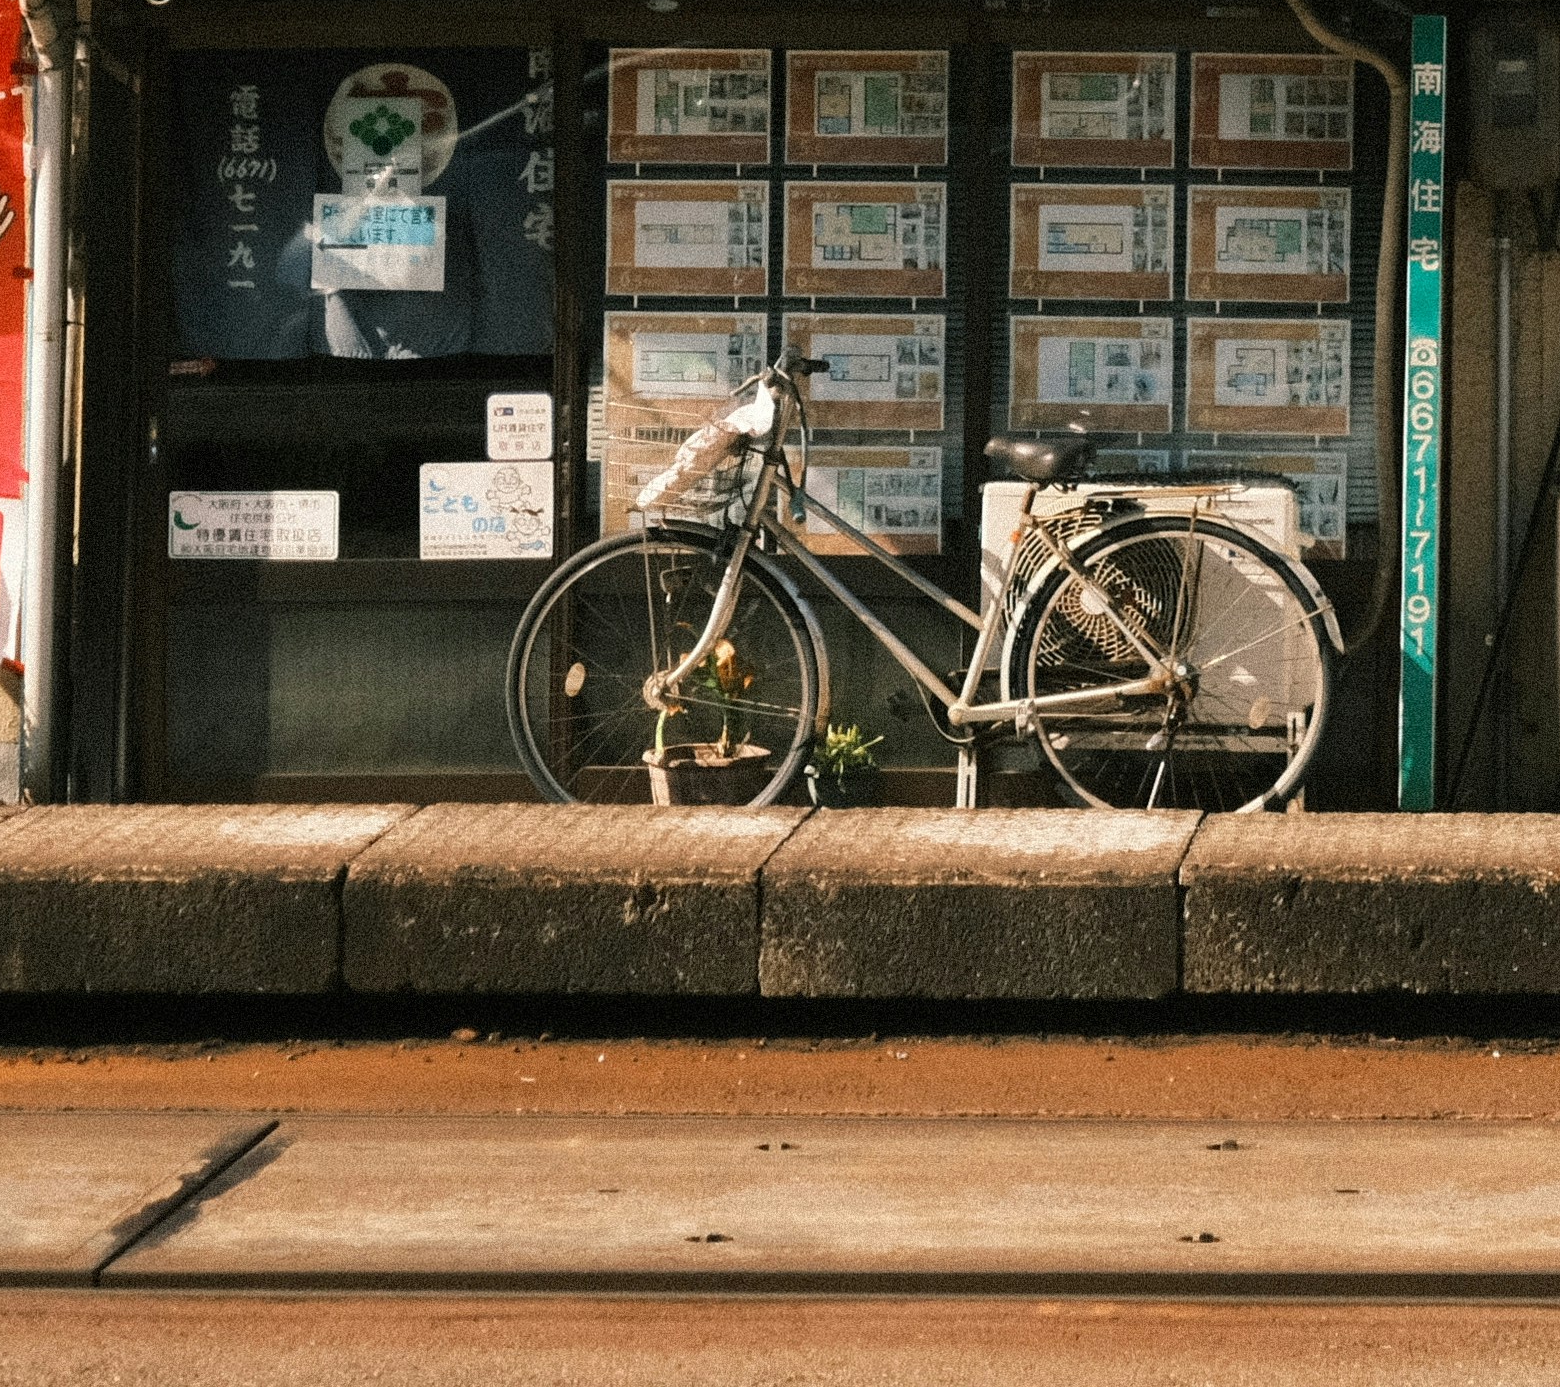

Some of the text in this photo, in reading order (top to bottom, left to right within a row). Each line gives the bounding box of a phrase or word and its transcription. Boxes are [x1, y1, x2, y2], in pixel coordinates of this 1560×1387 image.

[1409, 61, 1444, 273] 南海住宅
[422, 494, 480, 514] こども
